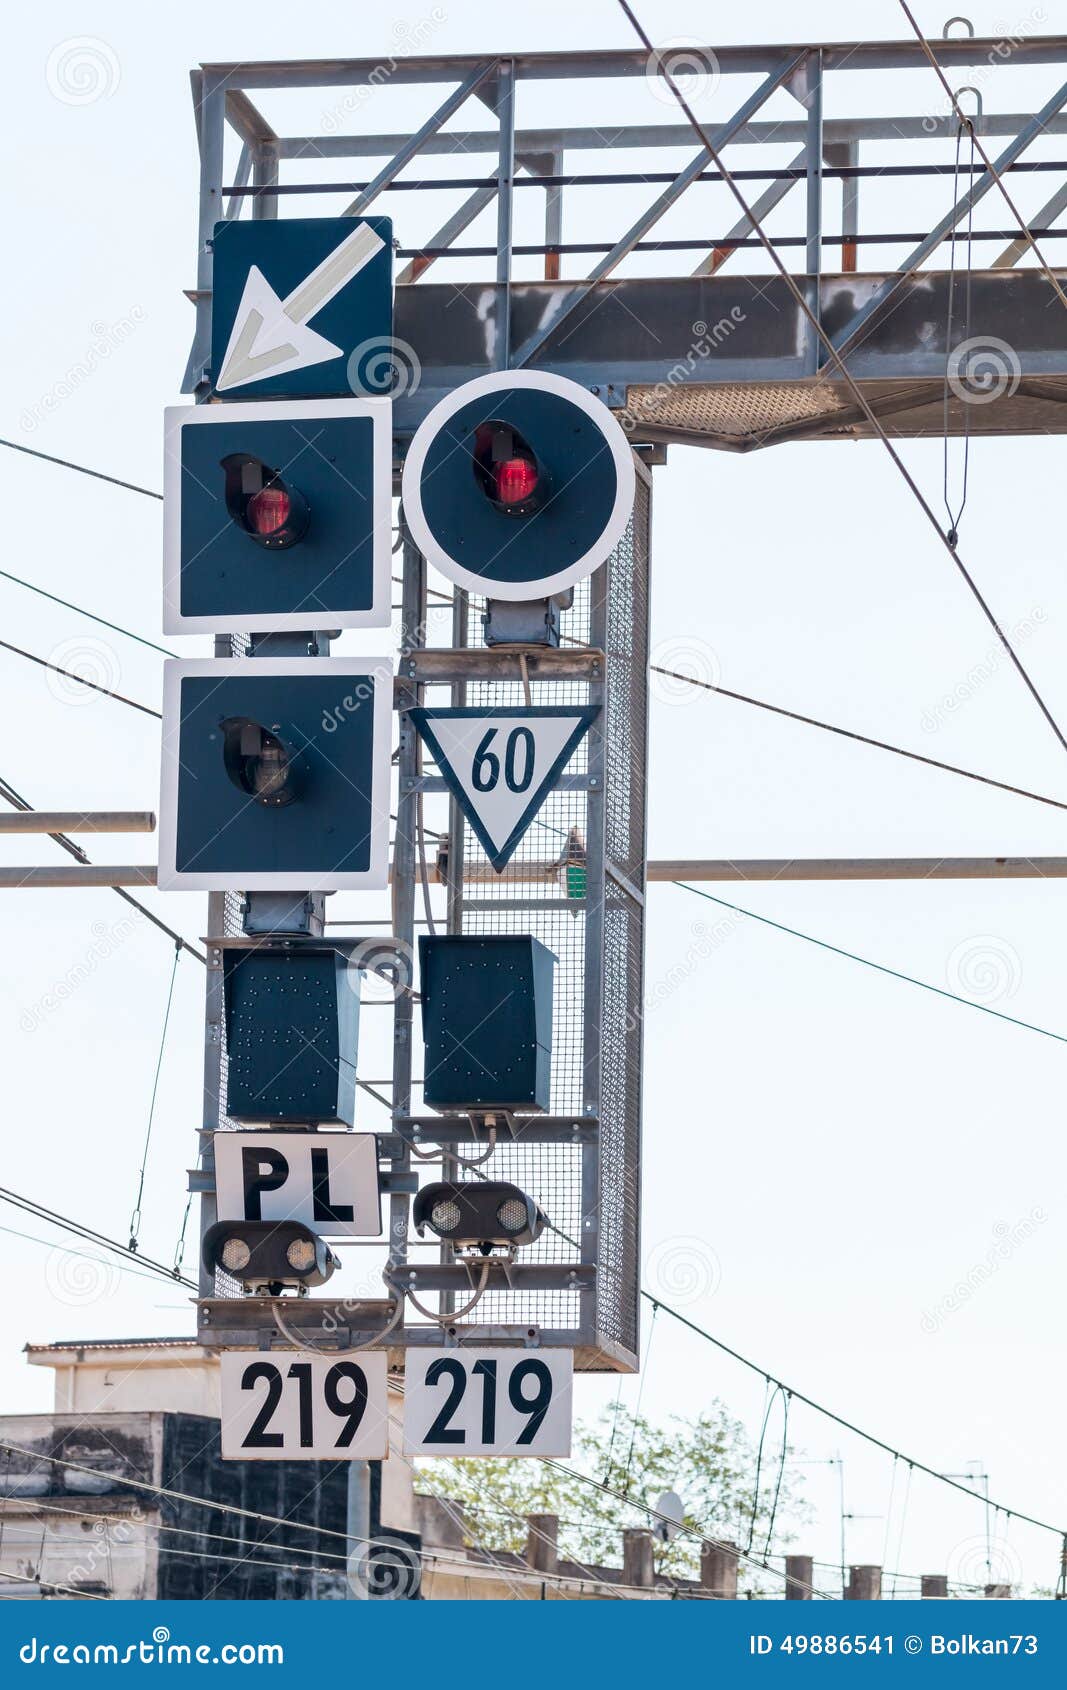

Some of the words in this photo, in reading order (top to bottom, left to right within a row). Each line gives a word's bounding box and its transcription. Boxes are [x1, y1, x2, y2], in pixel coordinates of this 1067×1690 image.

[471, 727, 536, 794] 60
[241, 1361, 368, 1448] 219
[422, 1357, 553, 1445] 219
